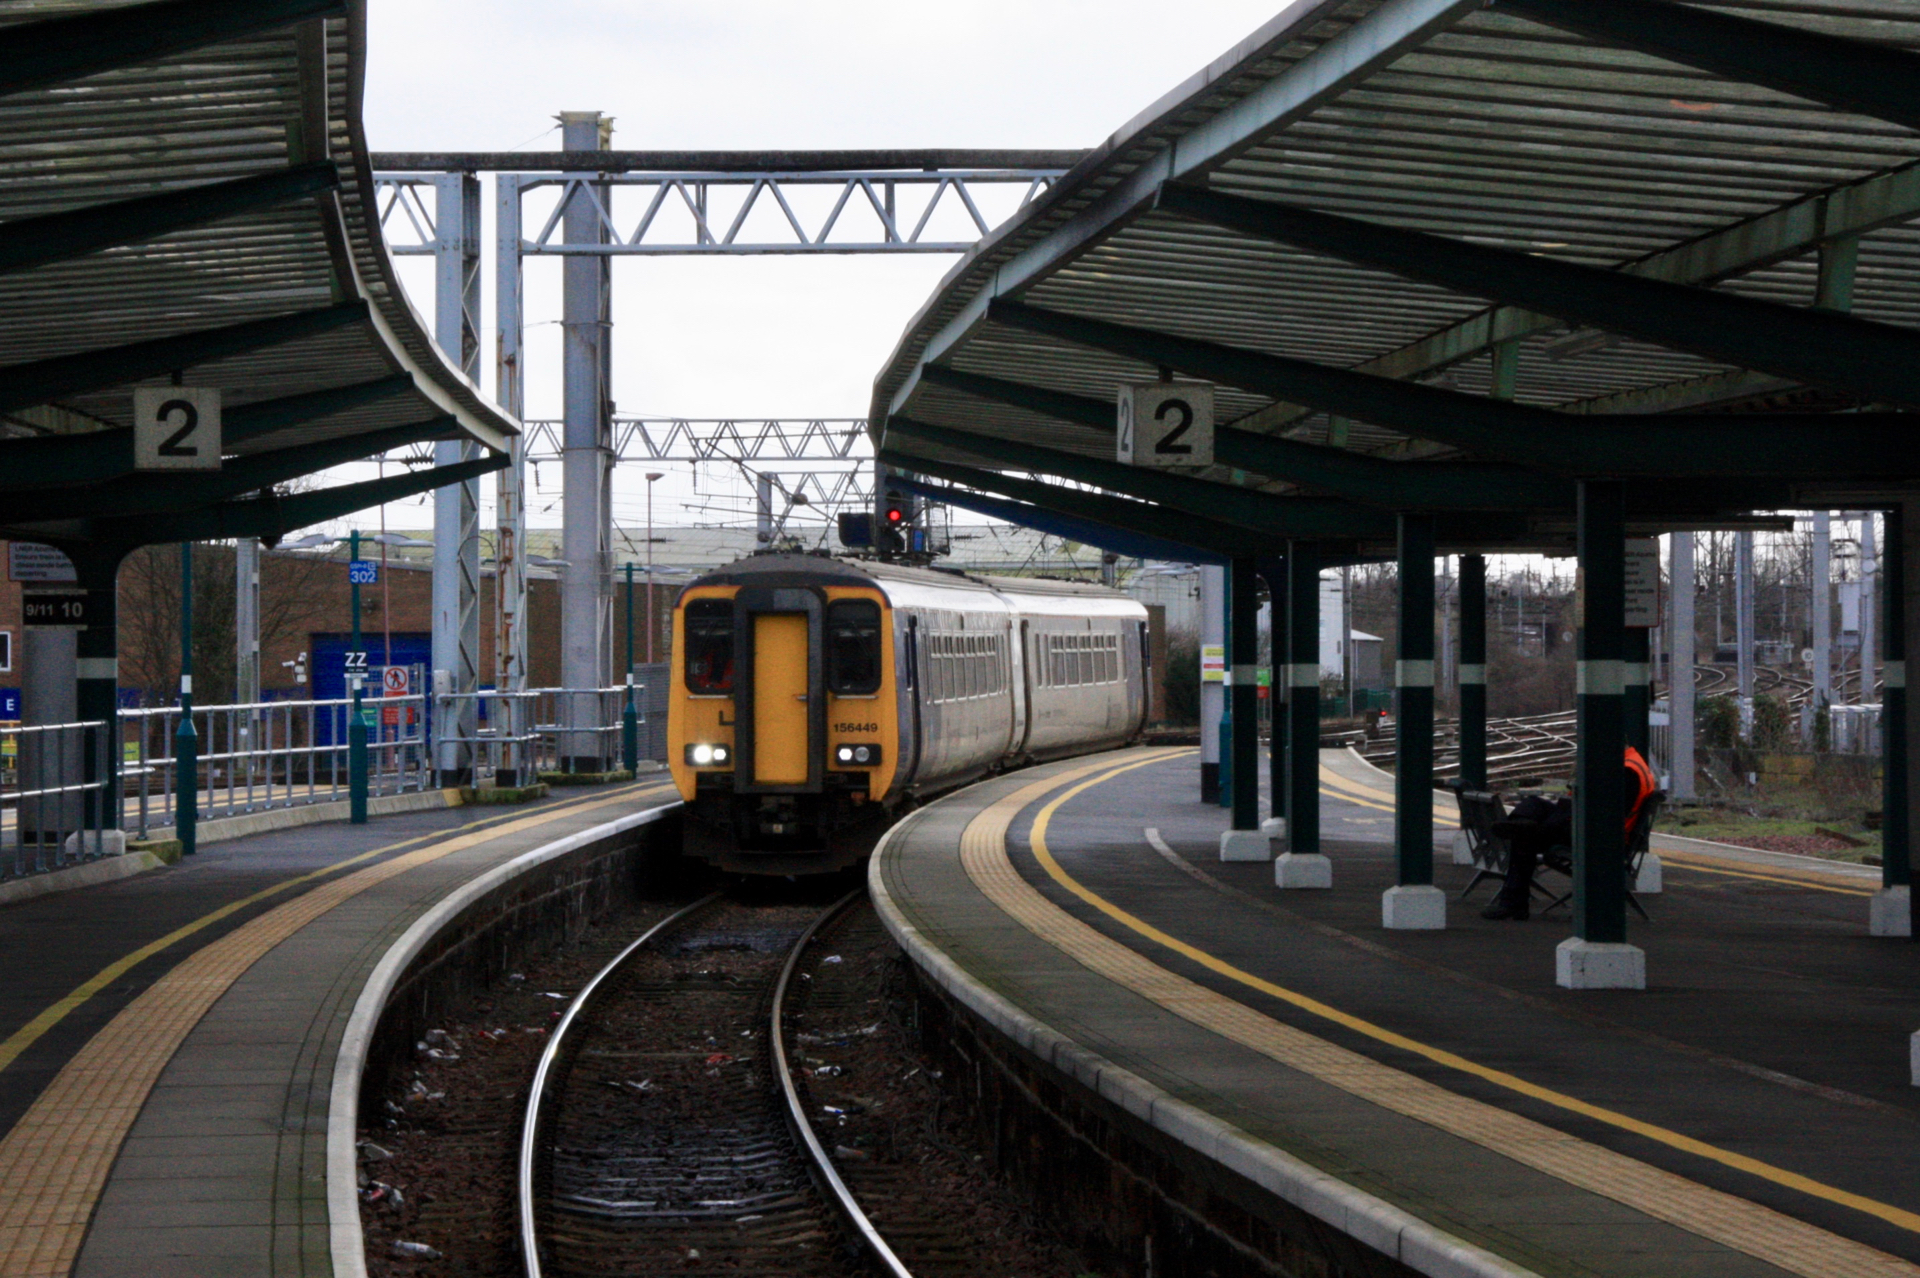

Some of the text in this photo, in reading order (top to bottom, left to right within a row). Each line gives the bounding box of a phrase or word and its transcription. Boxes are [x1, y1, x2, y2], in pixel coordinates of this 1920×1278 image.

[156, 399, 198, 457] 2
[1121, 398, 1130, 453] 2
[1154, 398, 1193, 454] 2
[14, 570, 47, 578] departing
[350, 570, 376, 583] 302
[26, 602, 83, 618] 9/11 10
[345, 652, 367, 667] ZZ
[833, 722, 878, 733] 156449
